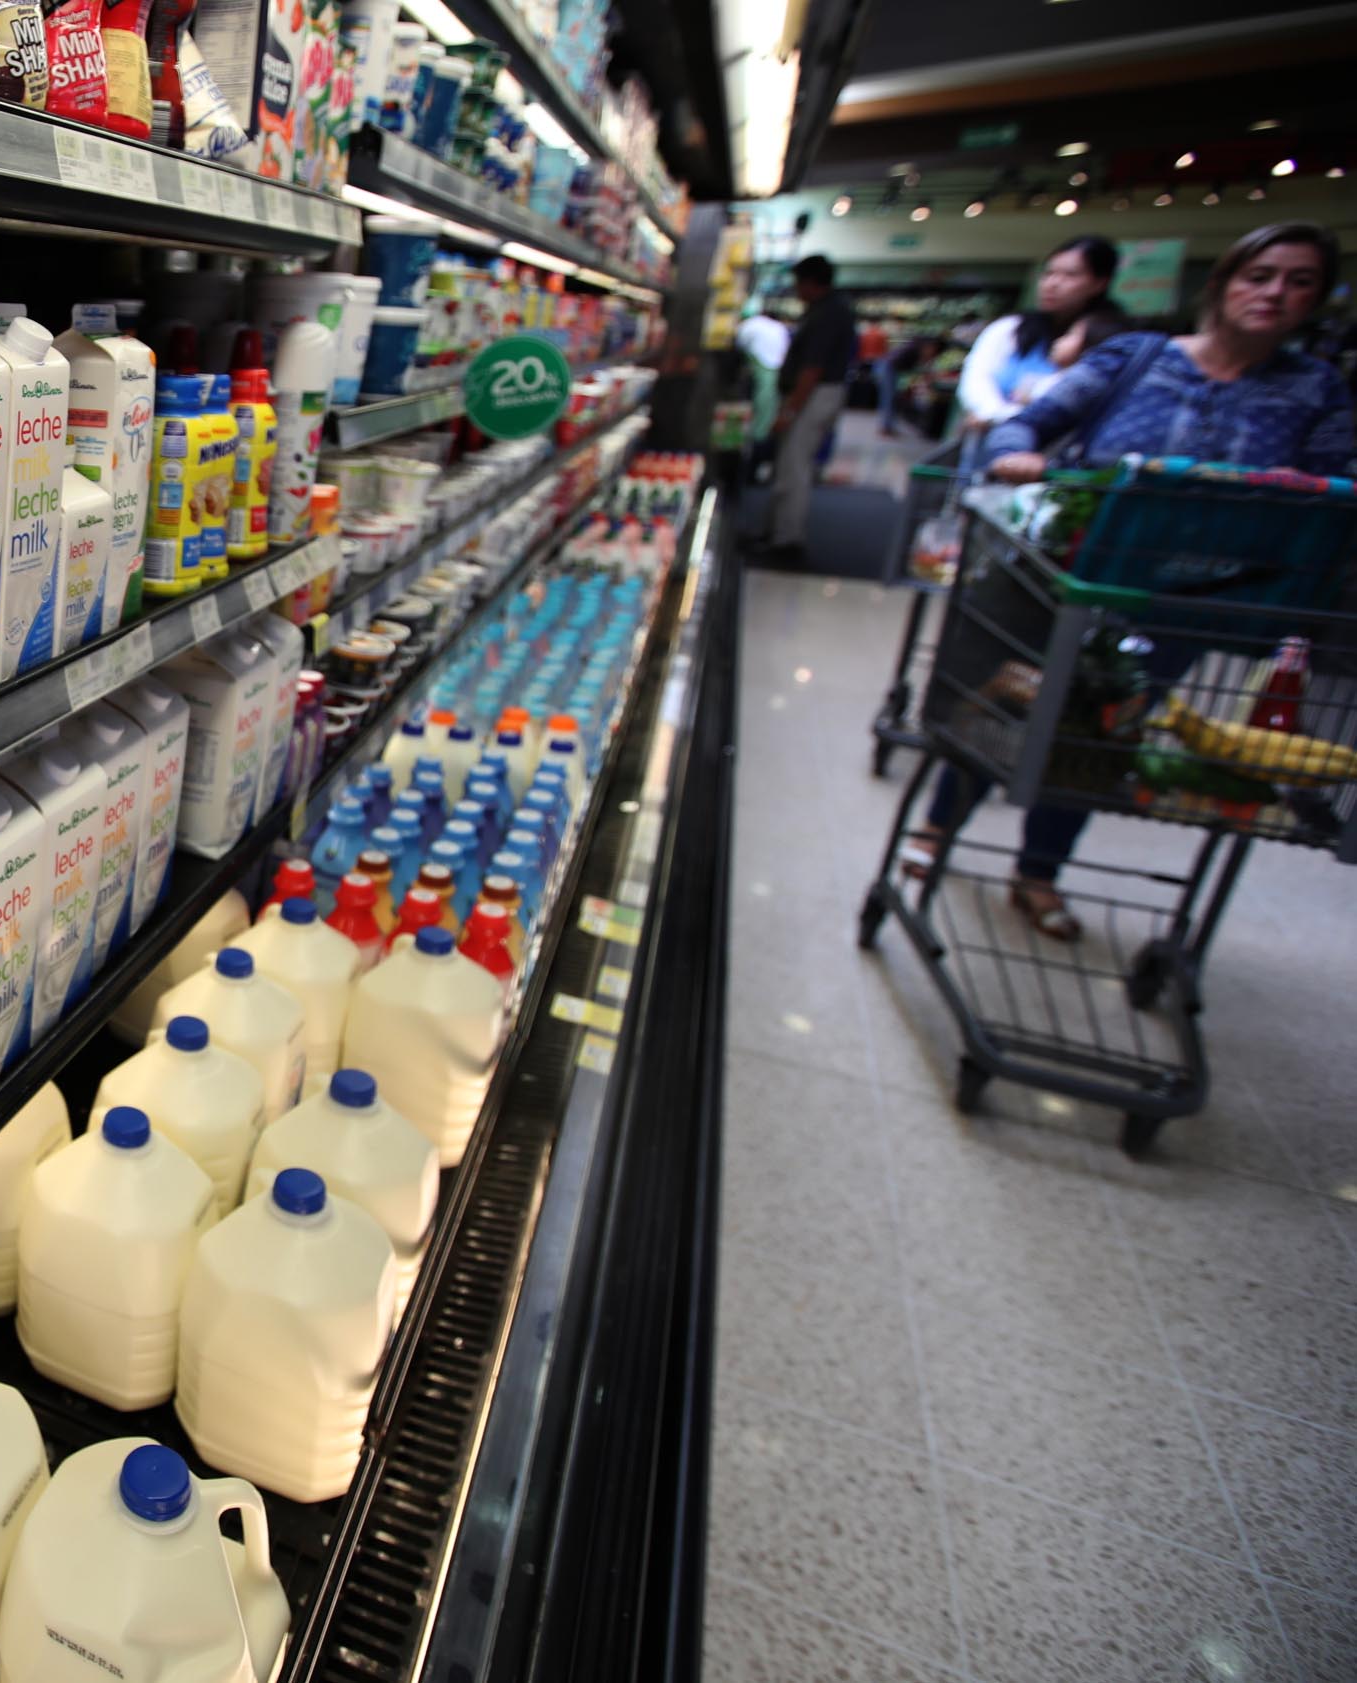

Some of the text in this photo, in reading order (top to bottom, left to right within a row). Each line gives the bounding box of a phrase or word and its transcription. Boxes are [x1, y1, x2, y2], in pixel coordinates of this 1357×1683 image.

[11, 16, 43, 46] Mil
[57, 31, 100, 58] Milk
[5, 48, 47, 78] SHA
[51, 55, 106, 87] SHAK
[16, 408, 63, 447] leche
[12, 481, 60, 522] leche
[113, 491, 139, 511] leche
[10, 518, 49, 560] milk
[69, 539, 95, 559] leche
[67, 578, 93, 598] leche
[66, 597, 87, 618] milk
[102, 791, 136, 828] leche
[54, 836, 94, 878] leche
[52, 865, 84, 906] milk
[51, 890, 92, 933] leche
[49, 923, 80, 962] milk
